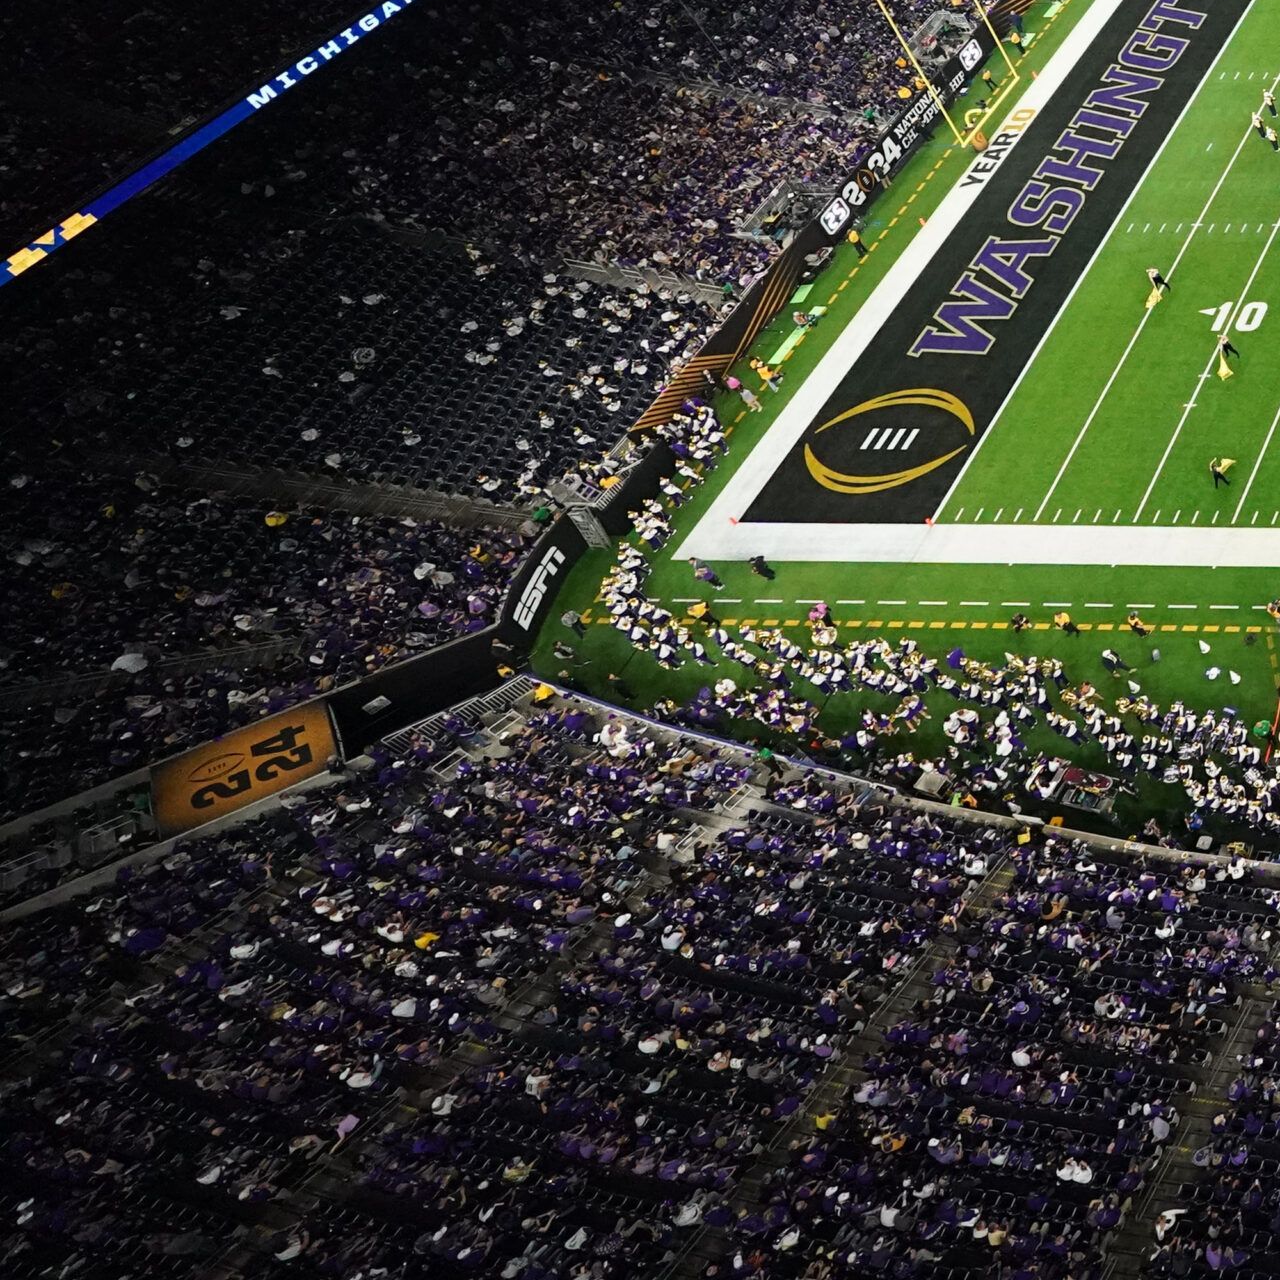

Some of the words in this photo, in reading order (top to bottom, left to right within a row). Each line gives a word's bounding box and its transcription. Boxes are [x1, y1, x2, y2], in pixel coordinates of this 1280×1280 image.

[894, 84, 942, 138] NATIONAL
[1209, 301, 1268, 333] 10
[513, 545, 567, 632] ESPN
